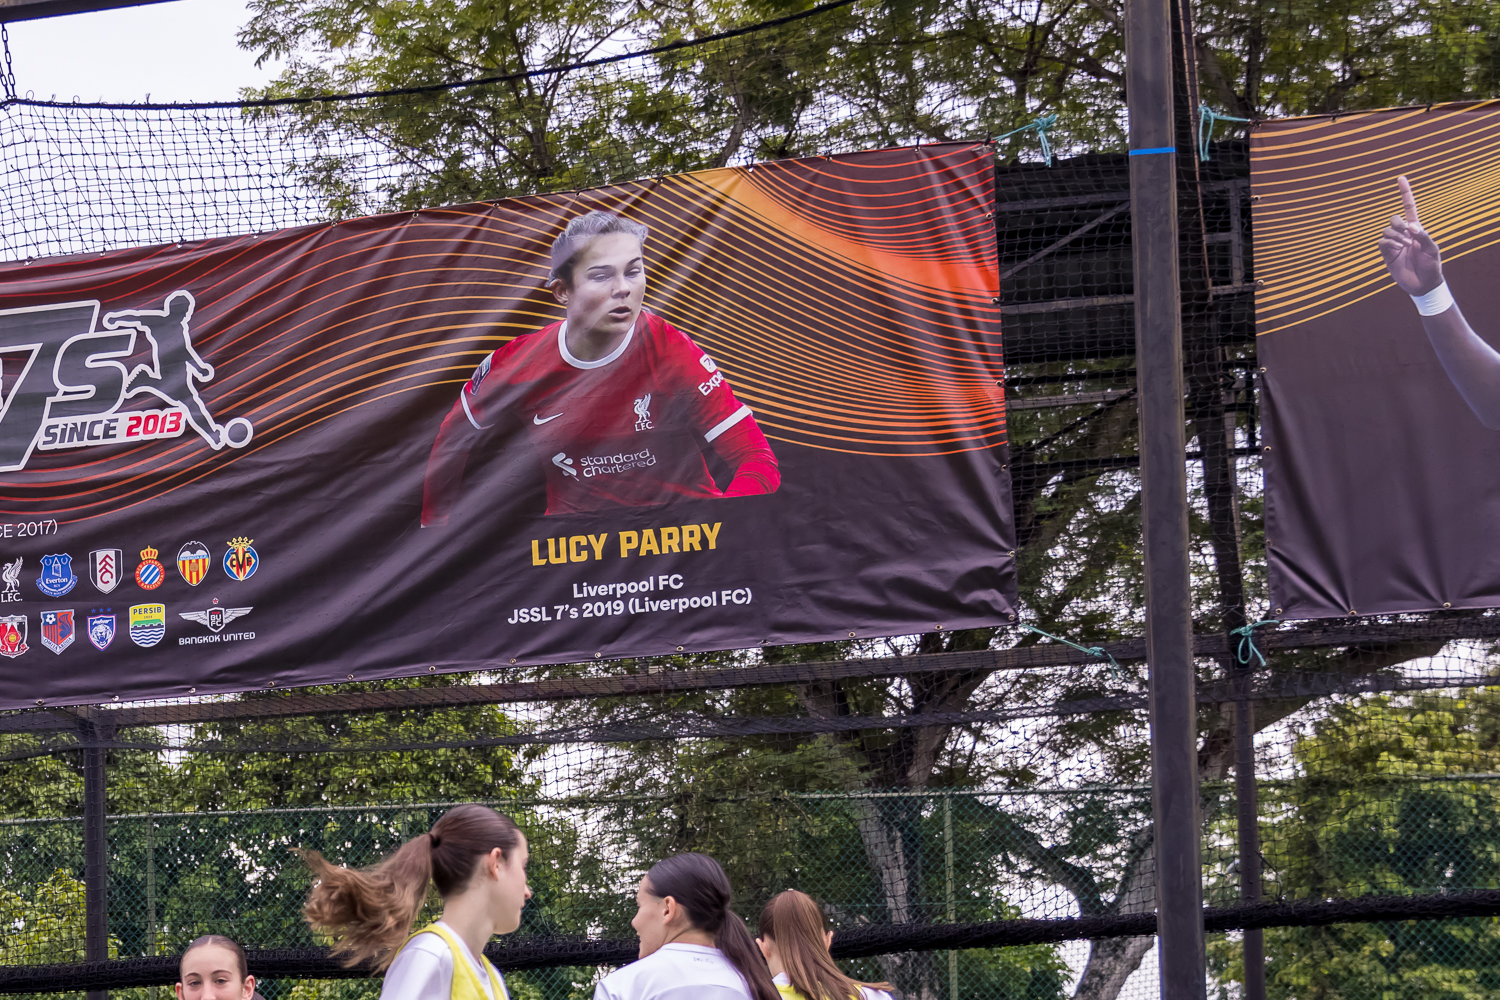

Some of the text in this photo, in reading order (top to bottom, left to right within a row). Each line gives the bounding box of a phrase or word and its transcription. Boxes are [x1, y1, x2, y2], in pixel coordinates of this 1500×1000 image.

[42, 411, 183, 446] SINCE 2013
[580, 449, 650, 467] standard
[583, 454, 657, 479] chartered
[17, 518, 58, 537] 2017)
[531, 521, 722, 567] LUCY PARRY
[572, 573, 684, 599] Liverpool FC
[133, 606, 162, 616] PERSIB
[507, 606, 552, 625] JSSL
[582, 599, 625, 618] 2019
[627, 591, 717, 615] (Liverpool
[721, 587, 753, 605] FC)
[178, 631, 256, 646] BANGKOK UNITED
